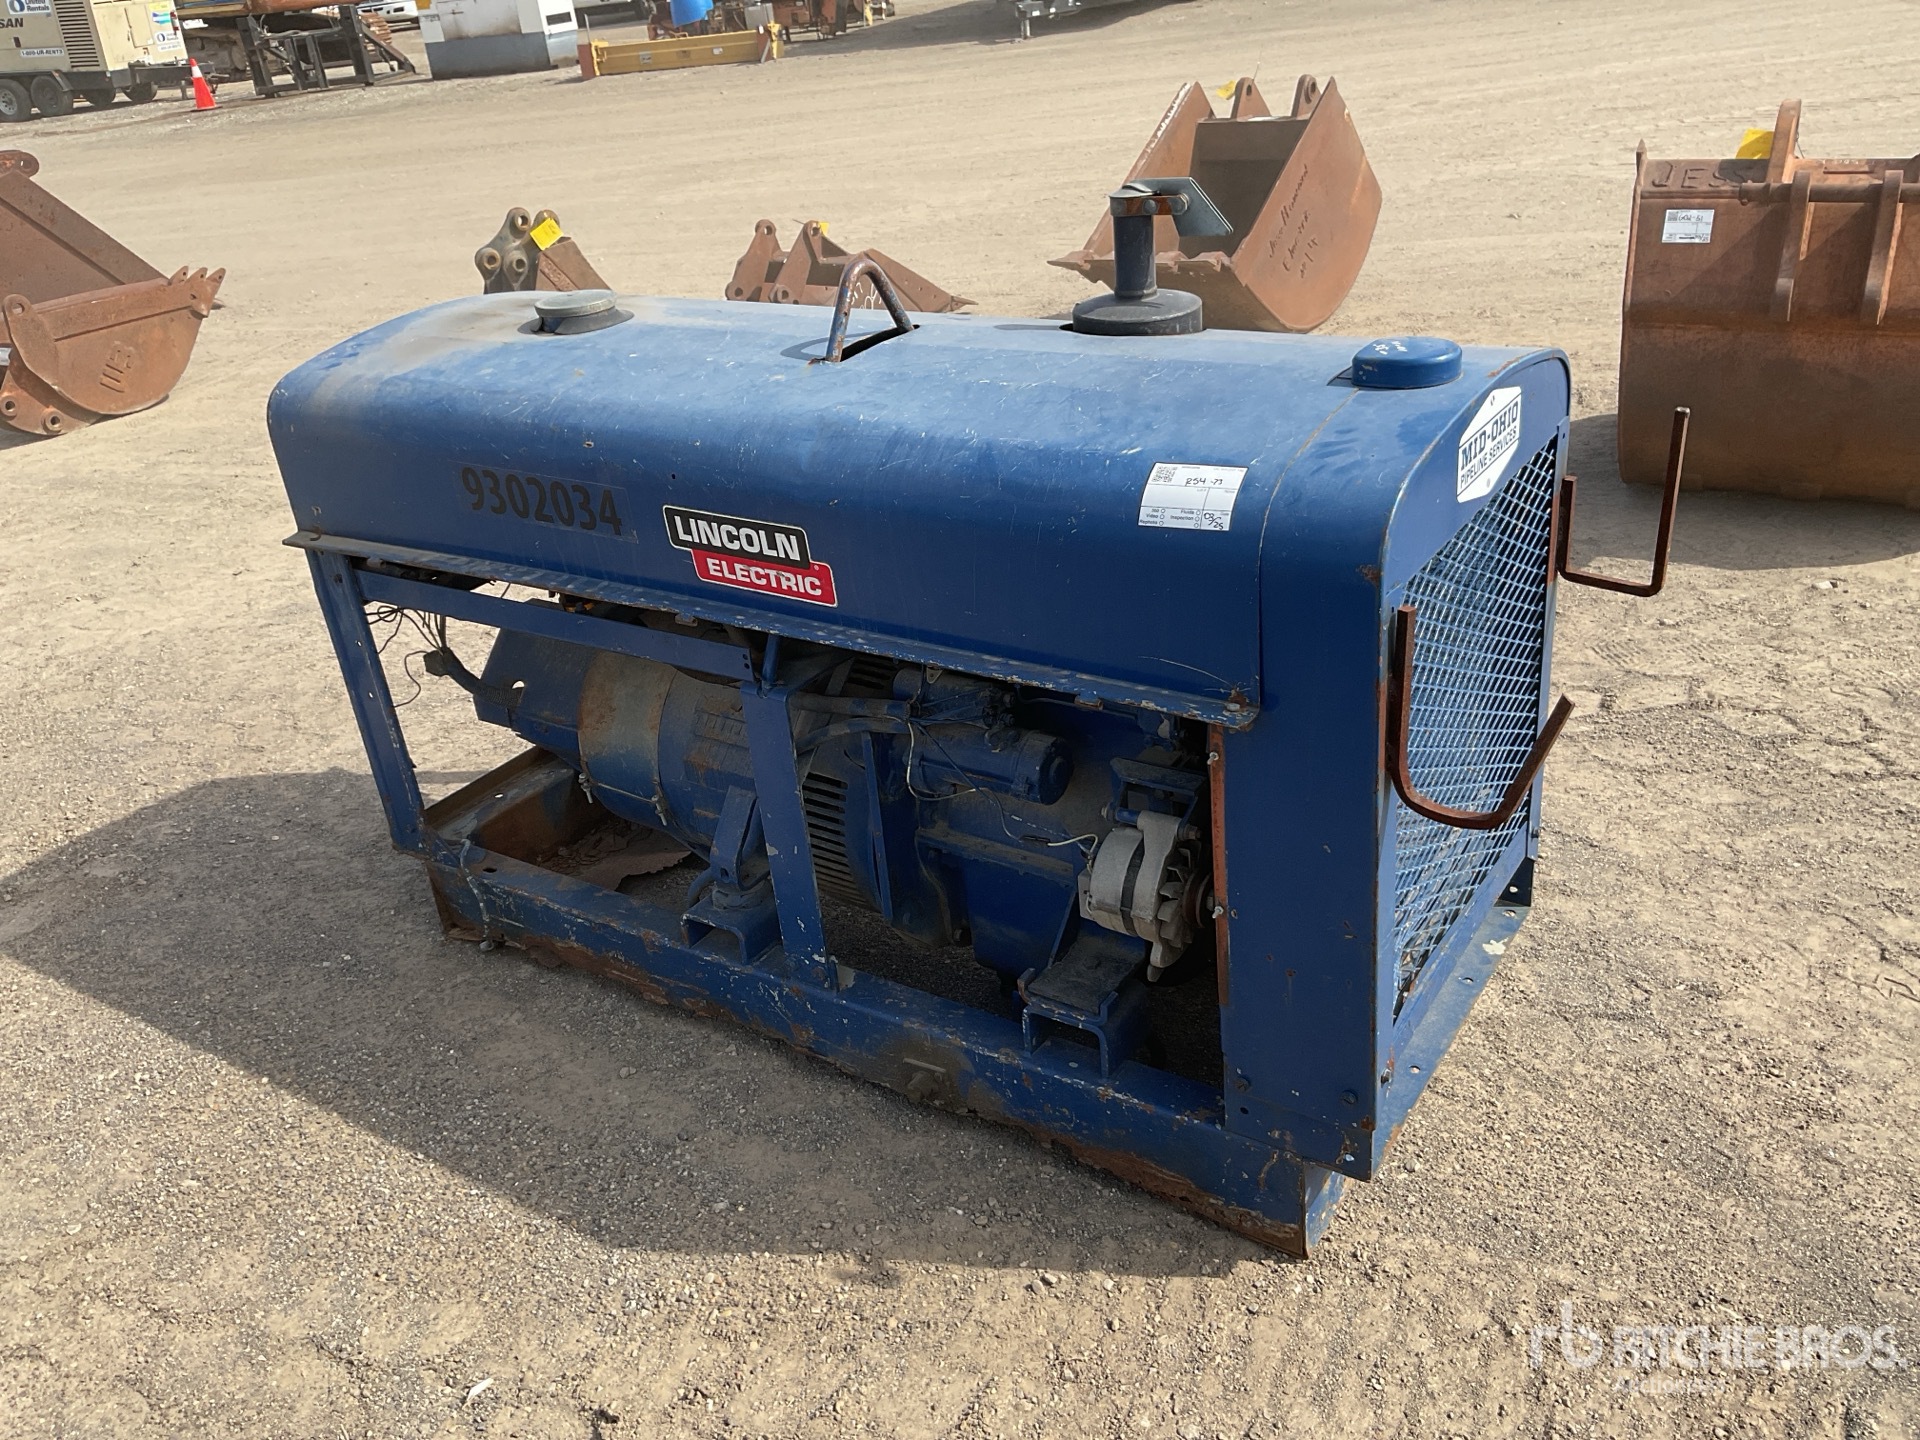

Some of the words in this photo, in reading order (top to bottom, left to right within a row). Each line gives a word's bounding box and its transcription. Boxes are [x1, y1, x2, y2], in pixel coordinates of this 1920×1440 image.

[1460, 452, 1488, 489] PIPELINE
[1488, 425, 1517, 463] SERVICES
[461, 467, 623, 537] 9302034
[674, 515, 801, 561] LINCOLN
[706, 557, 822, 596] ELECTRIC
